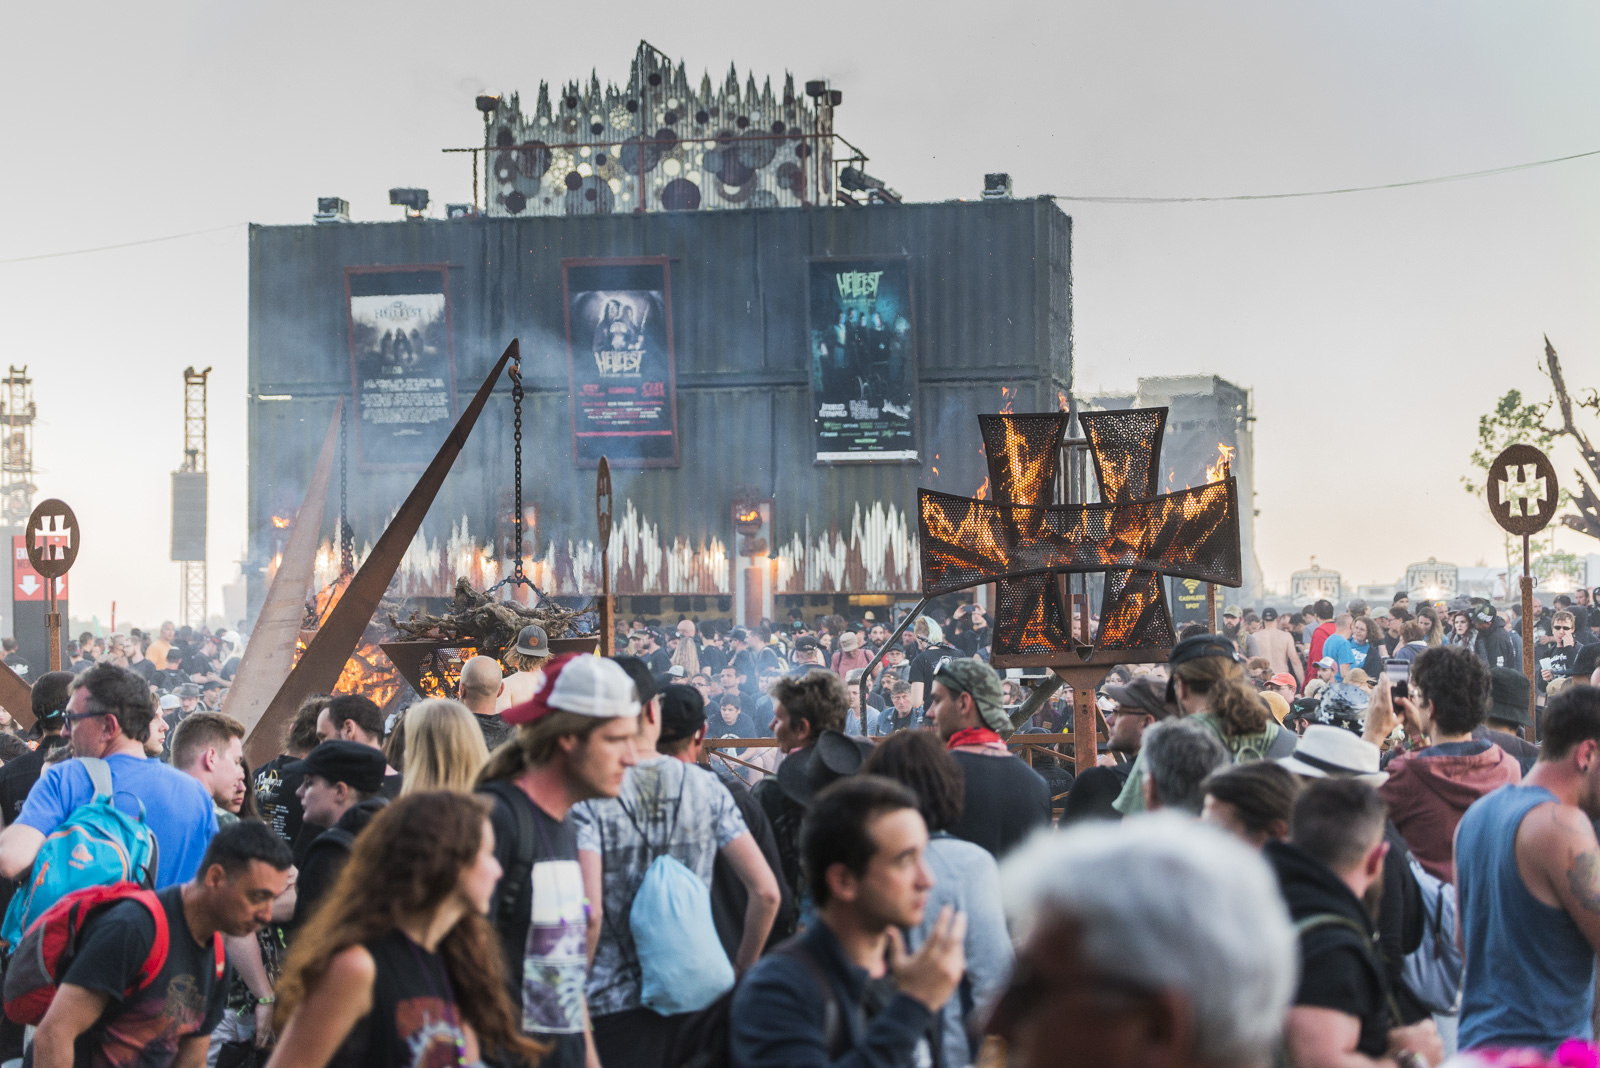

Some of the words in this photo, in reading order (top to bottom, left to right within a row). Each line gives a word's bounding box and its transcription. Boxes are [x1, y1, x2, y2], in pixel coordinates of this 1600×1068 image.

[836, 270, 884, 298] HELLFEST
[594, 349, 647, 374] HELLFEST
[1178, 594, 1206, 602] CASHLESS
